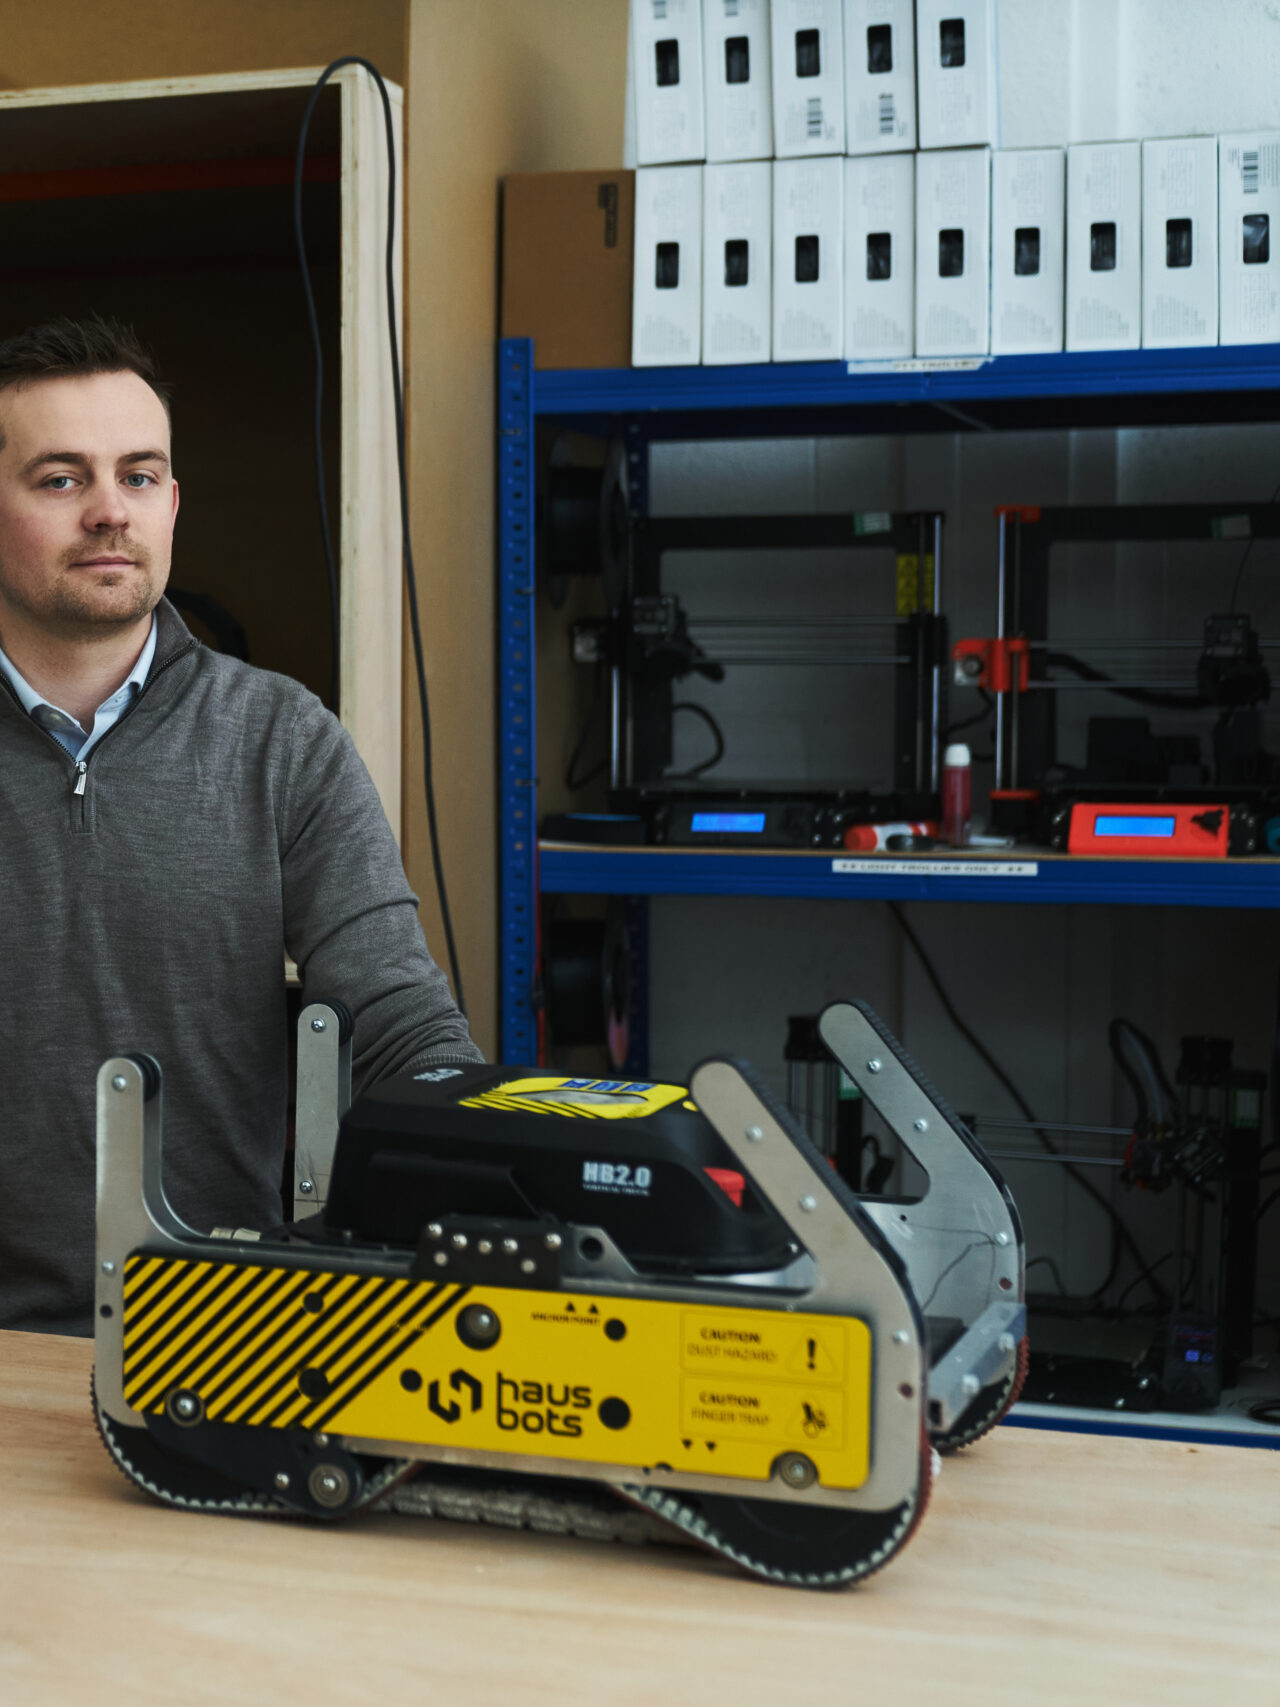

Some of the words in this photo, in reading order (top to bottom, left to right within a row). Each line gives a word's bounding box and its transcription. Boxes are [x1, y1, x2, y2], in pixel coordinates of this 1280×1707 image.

[583, 1161, 652, 1188] HB2.0
[700, 1327, 761, 1344] CAUTION
[687, 1343, 720, 1357] DUST
[496, 1369, 592, 1409] haus
[699, 1390, 760, 1408] CAUTION
[496, 1408, 583, 1437] bots
[691, 1408, 735, 1423] FINGER
[738, 1411, 771, 1427] TRAP
